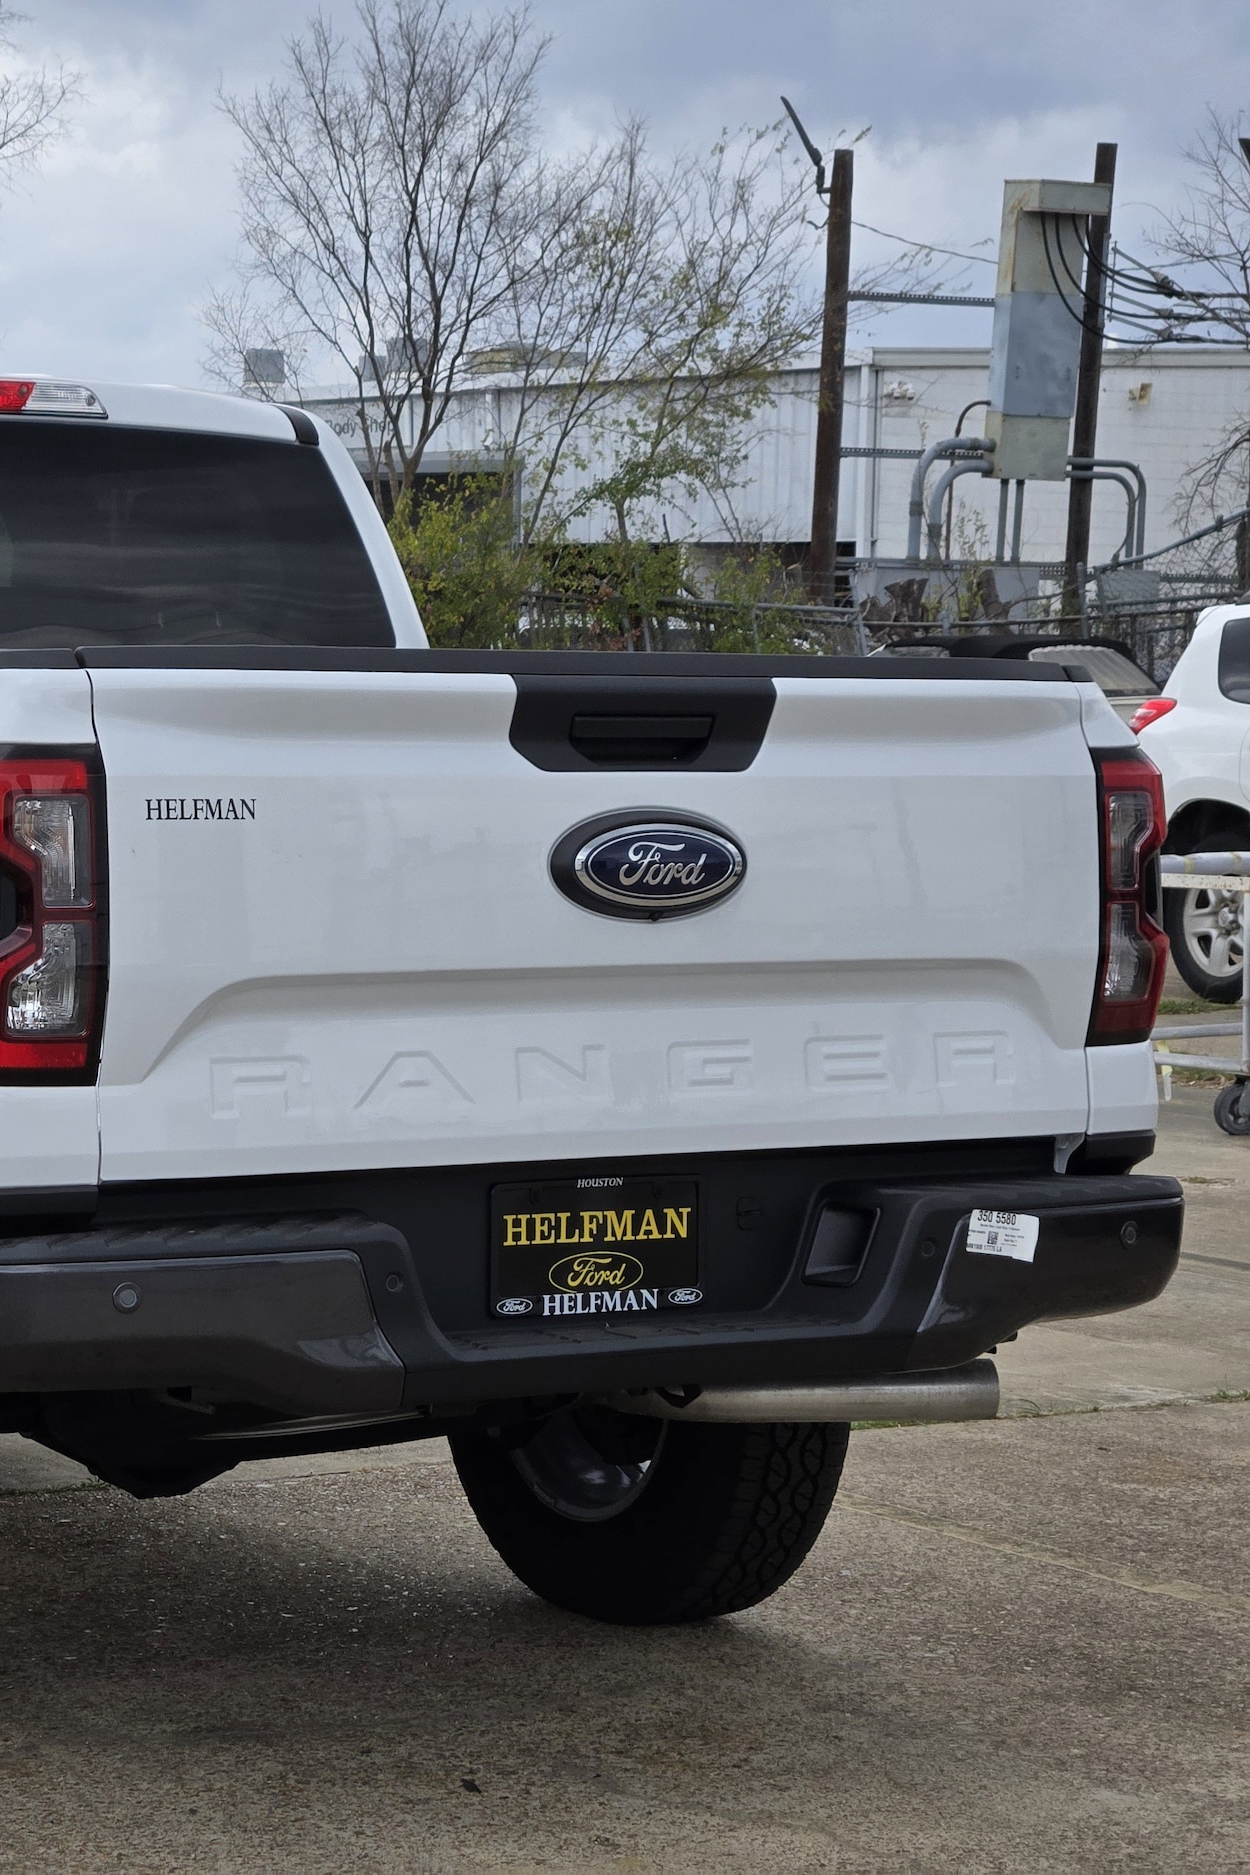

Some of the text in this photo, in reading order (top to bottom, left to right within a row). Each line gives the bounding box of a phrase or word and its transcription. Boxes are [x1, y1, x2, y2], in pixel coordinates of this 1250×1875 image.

[144, 798, 257, 820] HELFMAN
[618, 841, 708, 886] Ford
[208, 1029, 1015, 1120] RANGER
[576, 1177, 624, 1189] HOUSTON
[503, 1207, 692, 1247] HELFMAN
[995, 1211, 1017, 1226] 5580
[566, 1256, 627, 1287] Ford
[502, 1300, 527, 1312] Ford
[542, 1288, 659, 1316] HELFMAN
[673, 1289, 697, 1302] Ford
